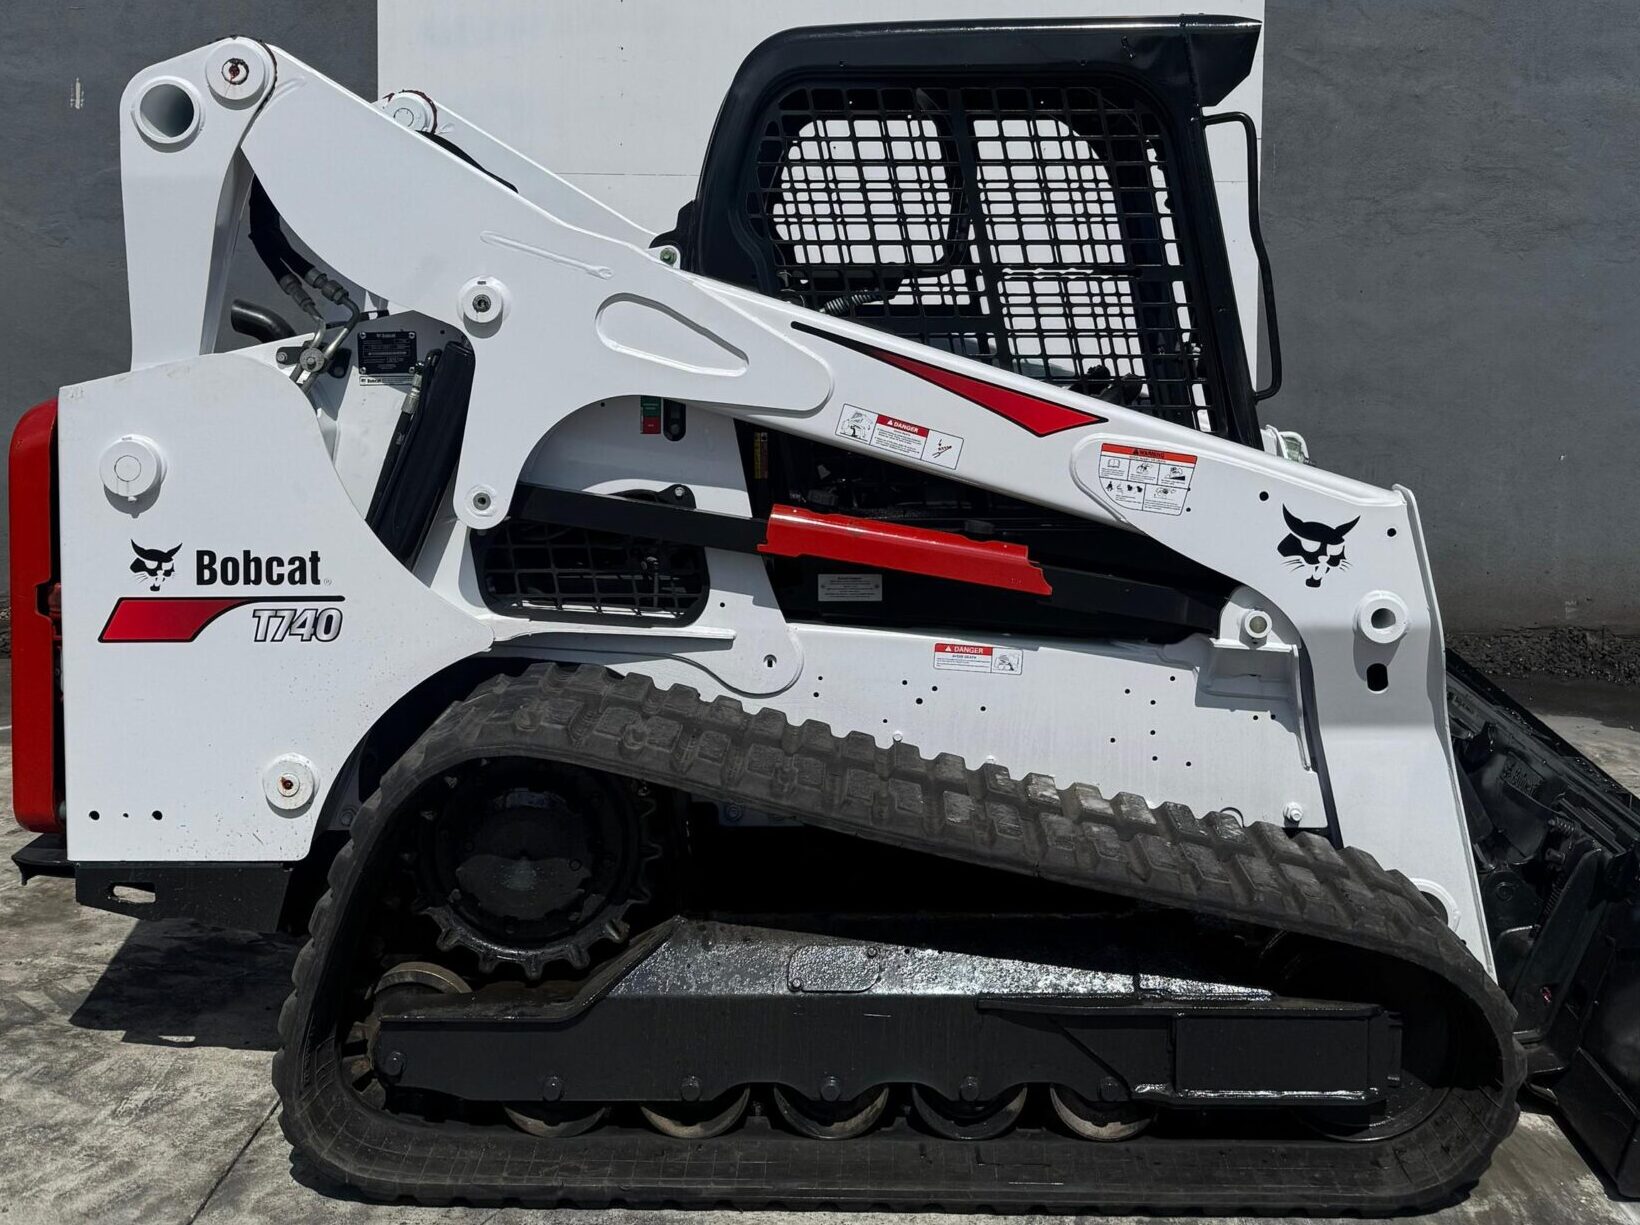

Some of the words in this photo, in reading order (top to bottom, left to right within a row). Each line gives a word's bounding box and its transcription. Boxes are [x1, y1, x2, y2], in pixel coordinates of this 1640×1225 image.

[893, 420, 919, 434] DANGER
[196, 550, 321, 585] Bobcat
[252, 607, 343, 642] T740
[954, 646, 984, 654] DANGER
